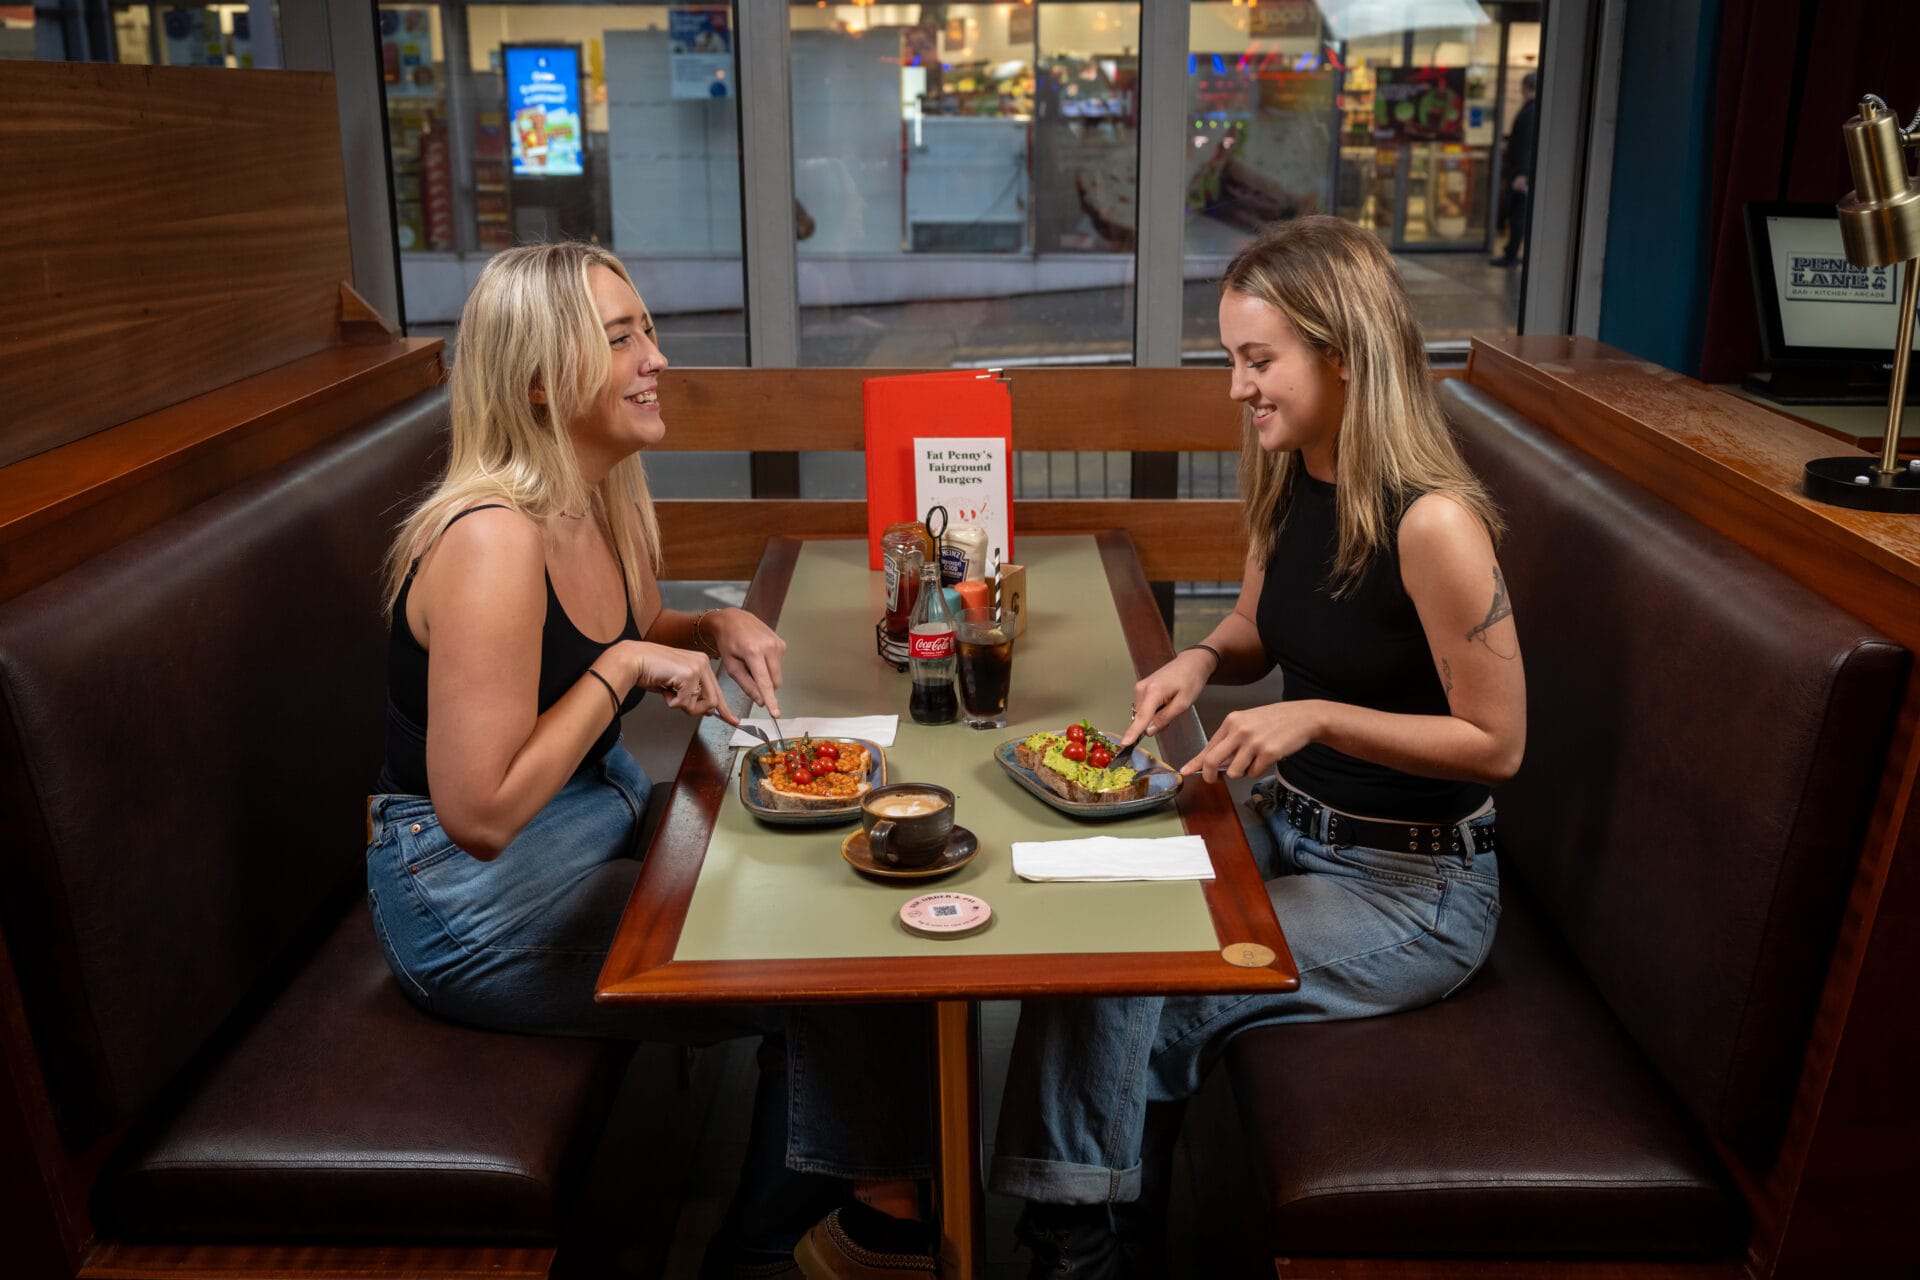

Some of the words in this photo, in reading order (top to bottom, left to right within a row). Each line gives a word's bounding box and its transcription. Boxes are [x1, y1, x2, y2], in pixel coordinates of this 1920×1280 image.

[1814, 289, 1848, 297] KITCHEN
[927, 450, 943, 460] Fat
[948, 450, 992, 461] Penny's
[929, 462, 991, 474] Fairground
[938, 475, 983, 486] Burgers
